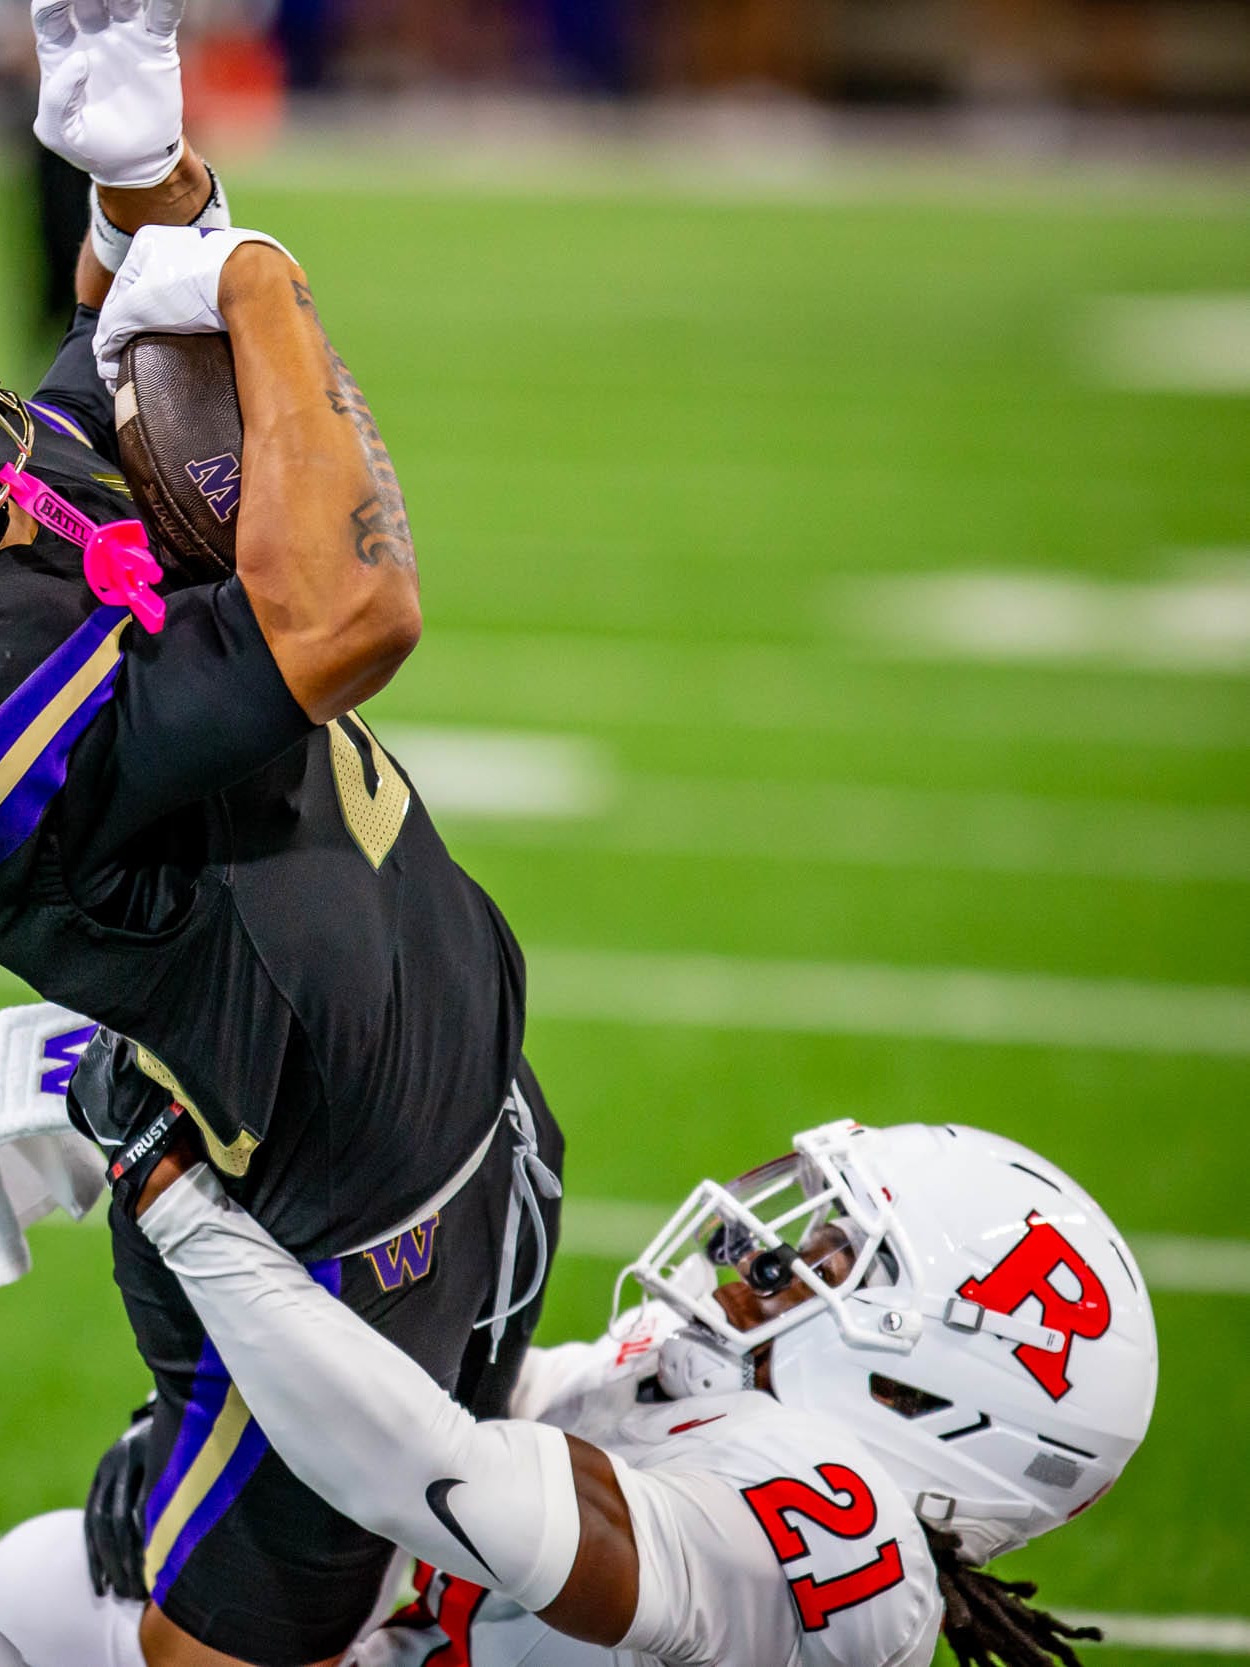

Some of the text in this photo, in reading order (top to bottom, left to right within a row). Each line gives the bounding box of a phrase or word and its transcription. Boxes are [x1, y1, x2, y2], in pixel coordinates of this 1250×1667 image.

[40, 497, 89, 541] BATTL
[184, 452, 242, 524] W
[126, 1117, 169, 1163] TRUST
[363, 1211, 439, 1292] W
[956, 1208, 1111, 1403] R
[739, 1463, 905, 1632] 21
